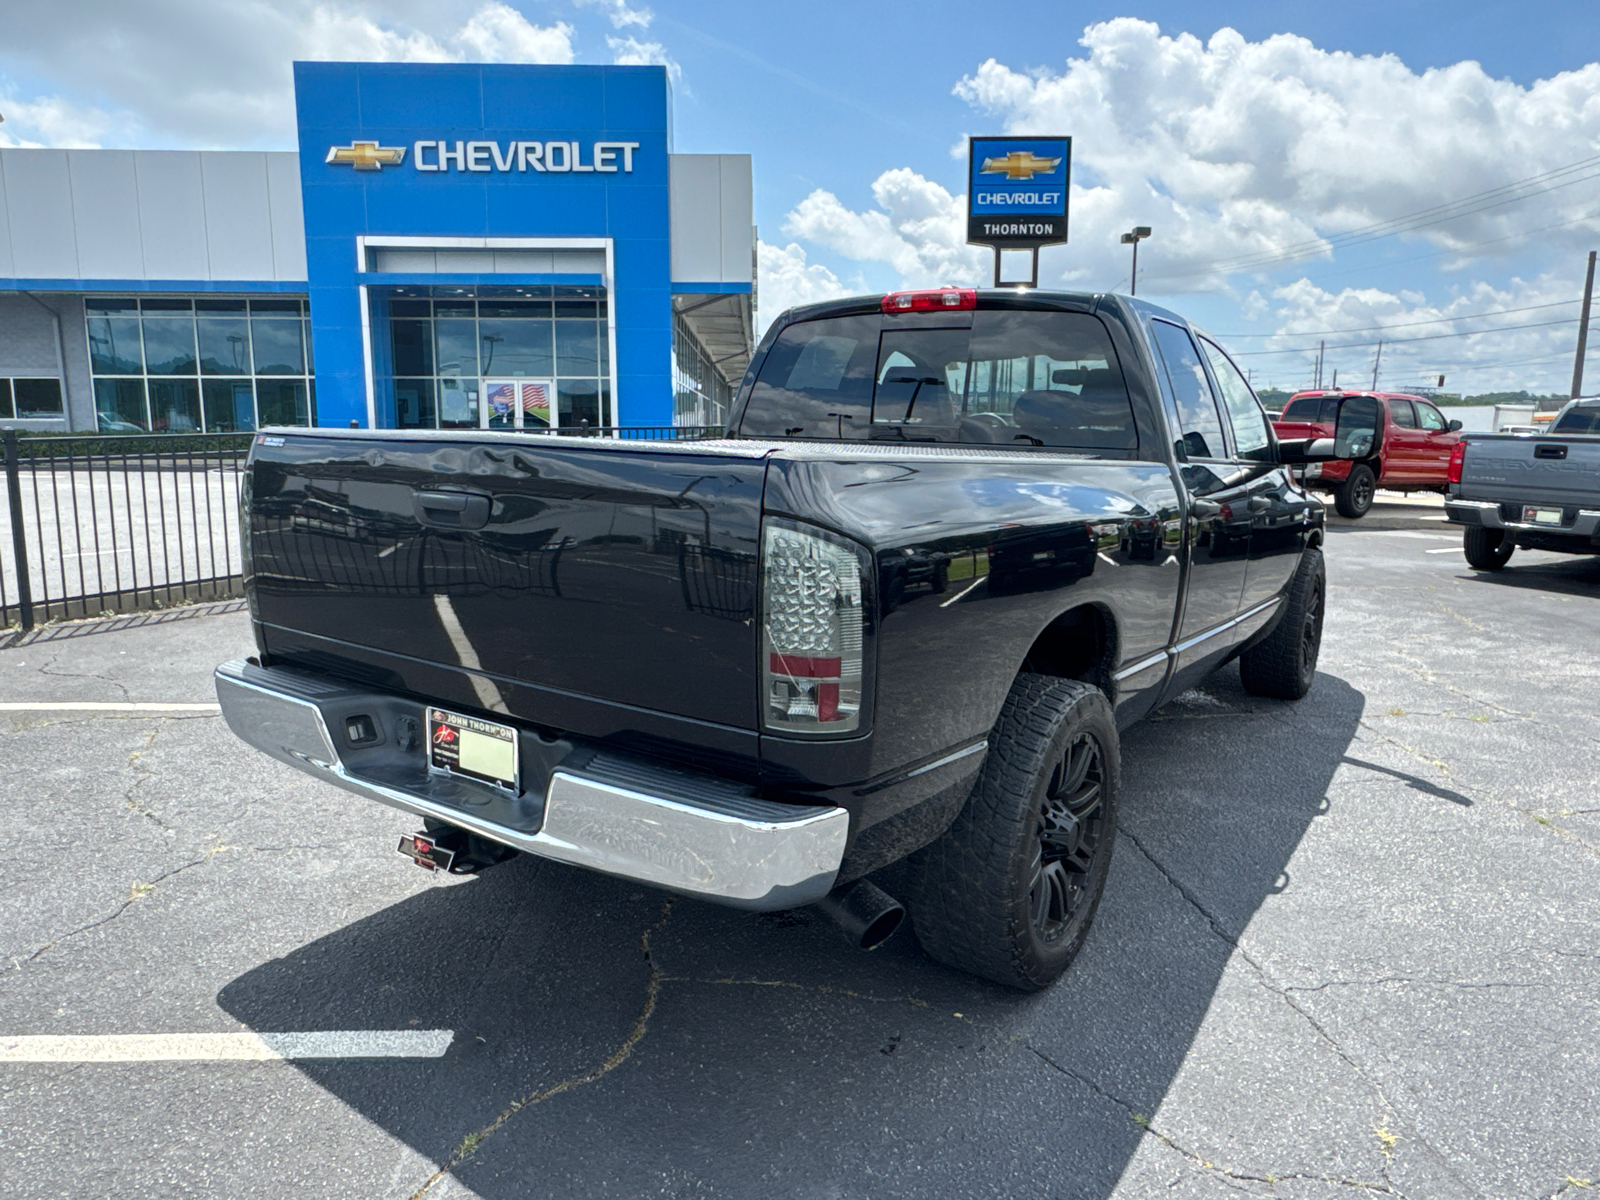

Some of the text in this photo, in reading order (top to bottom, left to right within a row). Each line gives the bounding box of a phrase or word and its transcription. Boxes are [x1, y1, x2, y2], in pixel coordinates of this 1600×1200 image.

[414, 141, 640, 172] CHEVROLET
[977, 192, 1061, 205] CHEVROLET
[983, 223, 1054, 235] THORNTON
[1469, 457, 1600, 475] CHEVROL
[447, 714, 468, 727] JOHN
